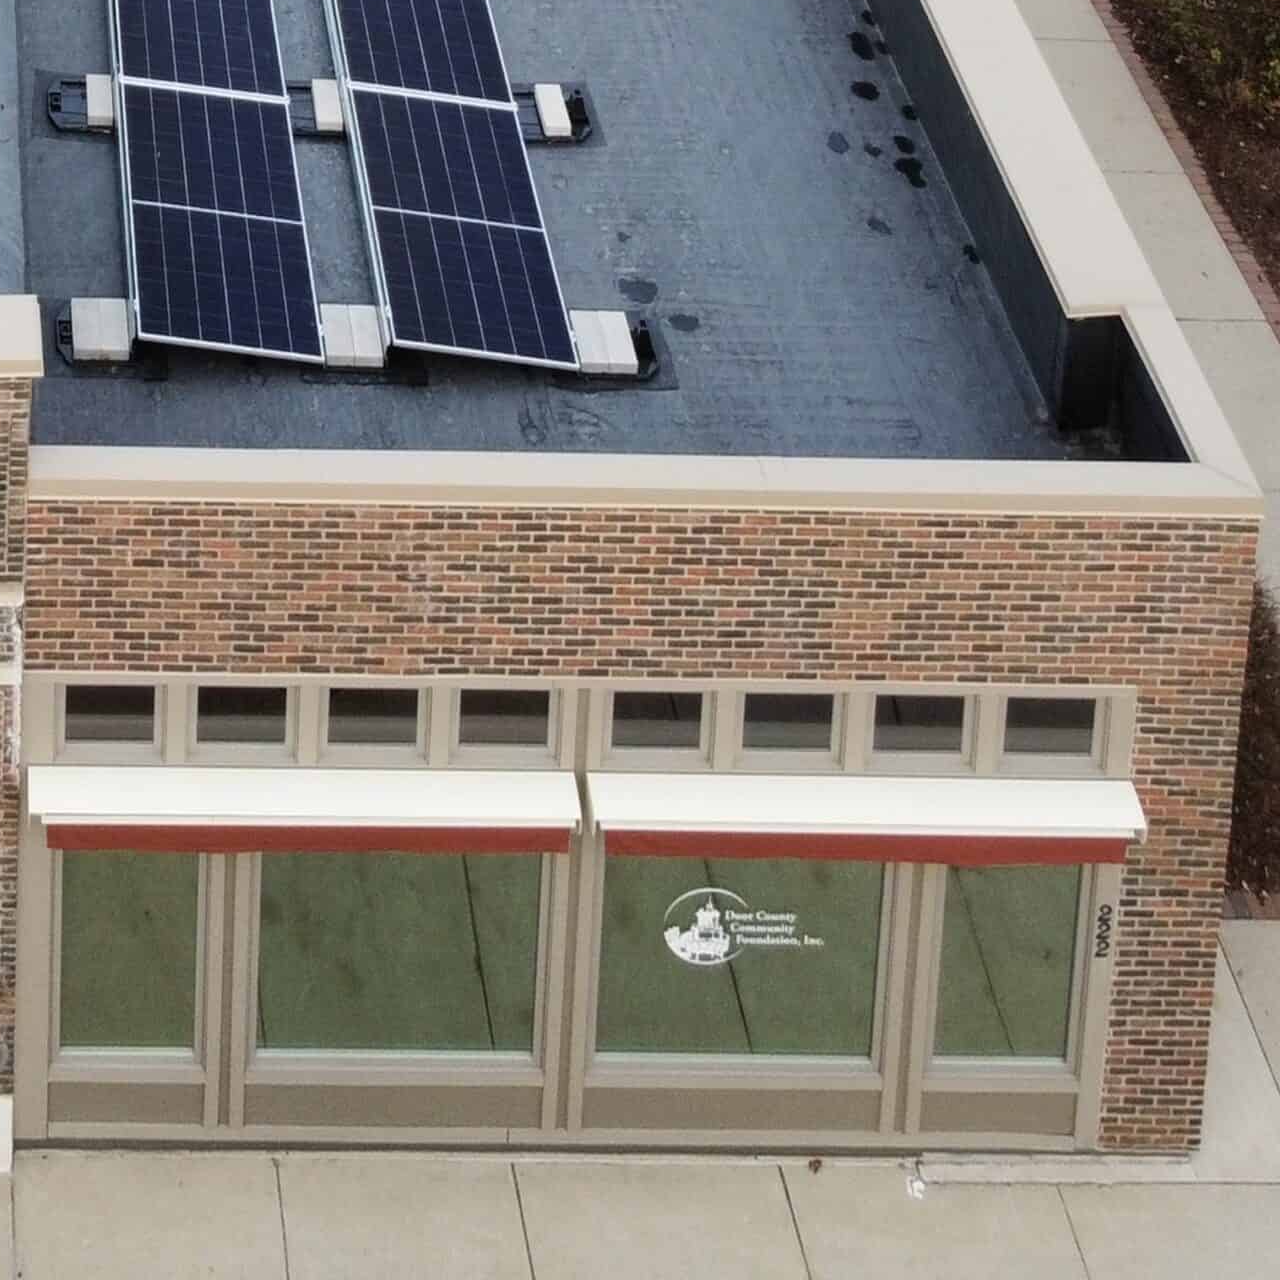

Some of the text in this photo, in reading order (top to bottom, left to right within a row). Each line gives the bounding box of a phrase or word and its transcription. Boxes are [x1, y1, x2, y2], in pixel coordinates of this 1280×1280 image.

[756, 910, 796, 924] County
[730, 922, 795, 936] Community
[1095, 904, 1112, 958] 222
[736, 934, 825, 947] Foundation, Inc.
